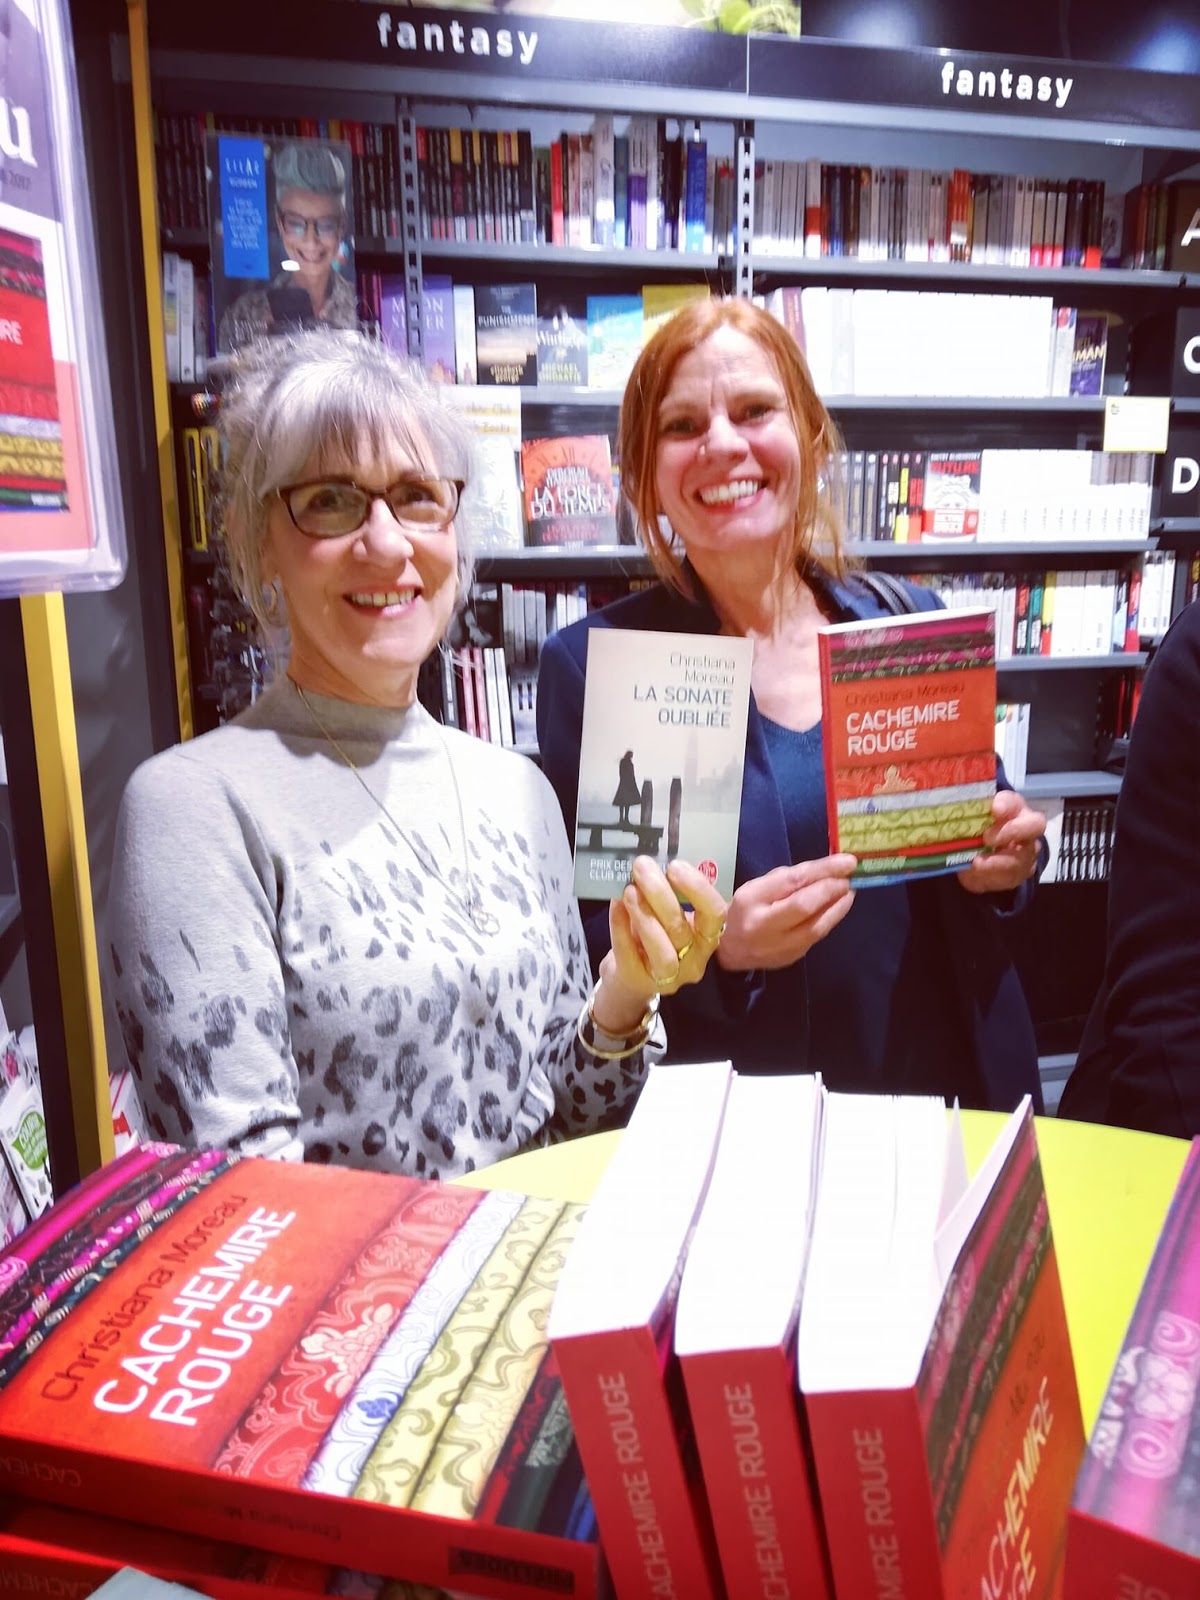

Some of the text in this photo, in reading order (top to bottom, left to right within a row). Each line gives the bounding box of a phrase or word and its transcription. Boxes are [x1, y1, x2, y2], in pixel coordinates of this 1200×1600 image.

[377, 12, 538, 65] fantasy
[941, 61, 1073, 108] fantasy
[1172, 457, 1200, 494] D
[530, 500, 557, 520] DU
[670, 651, 735, 670] Christiana
[685, 669, 735, 685] Moreau
[634, 684, 733, 706] LA SONATE
[658, 705, 731, 728] OUBLIÉE
[846, 699, 960, 735] CACHEMIRE
[847, 728, 918, 757] ROUGE
[589, 869, 614, 882] CLUB
[590, 858, 612, 870] PRIX
[41, 1194, 248, 1402] Christiana Moreau
[93, 1206, 297, 1414] CACHEMIRE
[149, 1279, 293, 1426] ROUGE
[723, 1382, 767, 1478] ROUGE
[599, 1372, 677, 1600] ROUGE ACHEMIRE
[853, 1427, 894, 1526] ROUGE
